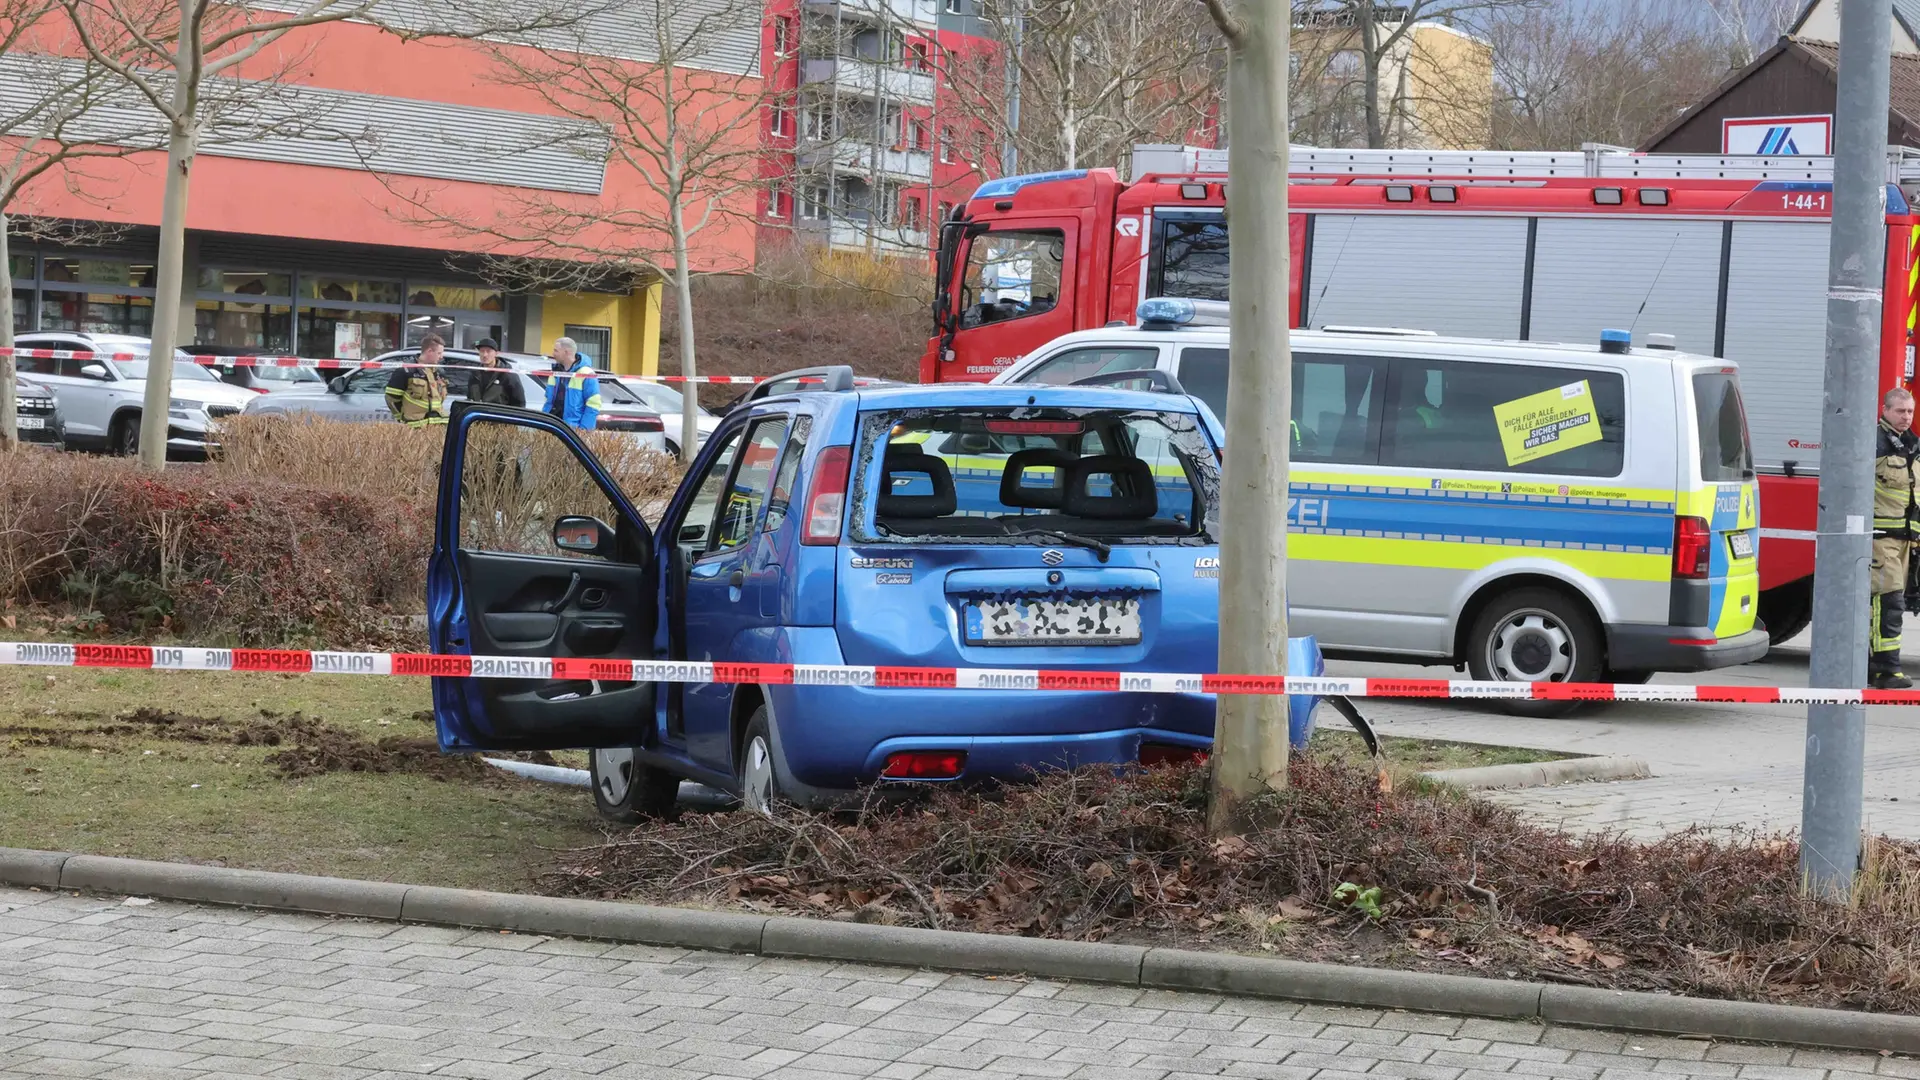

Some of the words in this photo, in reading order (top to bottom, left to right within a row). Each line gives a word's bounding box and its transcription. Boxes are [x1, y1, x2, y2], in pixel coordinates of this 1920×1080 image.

[1782, 194, 1826, 210] 1-44-1
[993, 357, 1012, 365] GERA
[967, 366, 1007, 374] FEUERWEH
[1504, 416, 1521, 428] DICH
[1523, 412, 1536, 422] FÜR
[1538, 407, 1554, 417] ALLE
[1531, 424, 1558, 438] SICHER
[1558, 414, 1589, 430] MACHEN
[1525, 437, 1540, 448] WIR
[1541, 433, 1558, 443] DAS.
[851, 557, 914, 568] SUZUKI
[1194, 557, 1220, 568] IGN
[1194, 569, 1220, 578] AUTO
